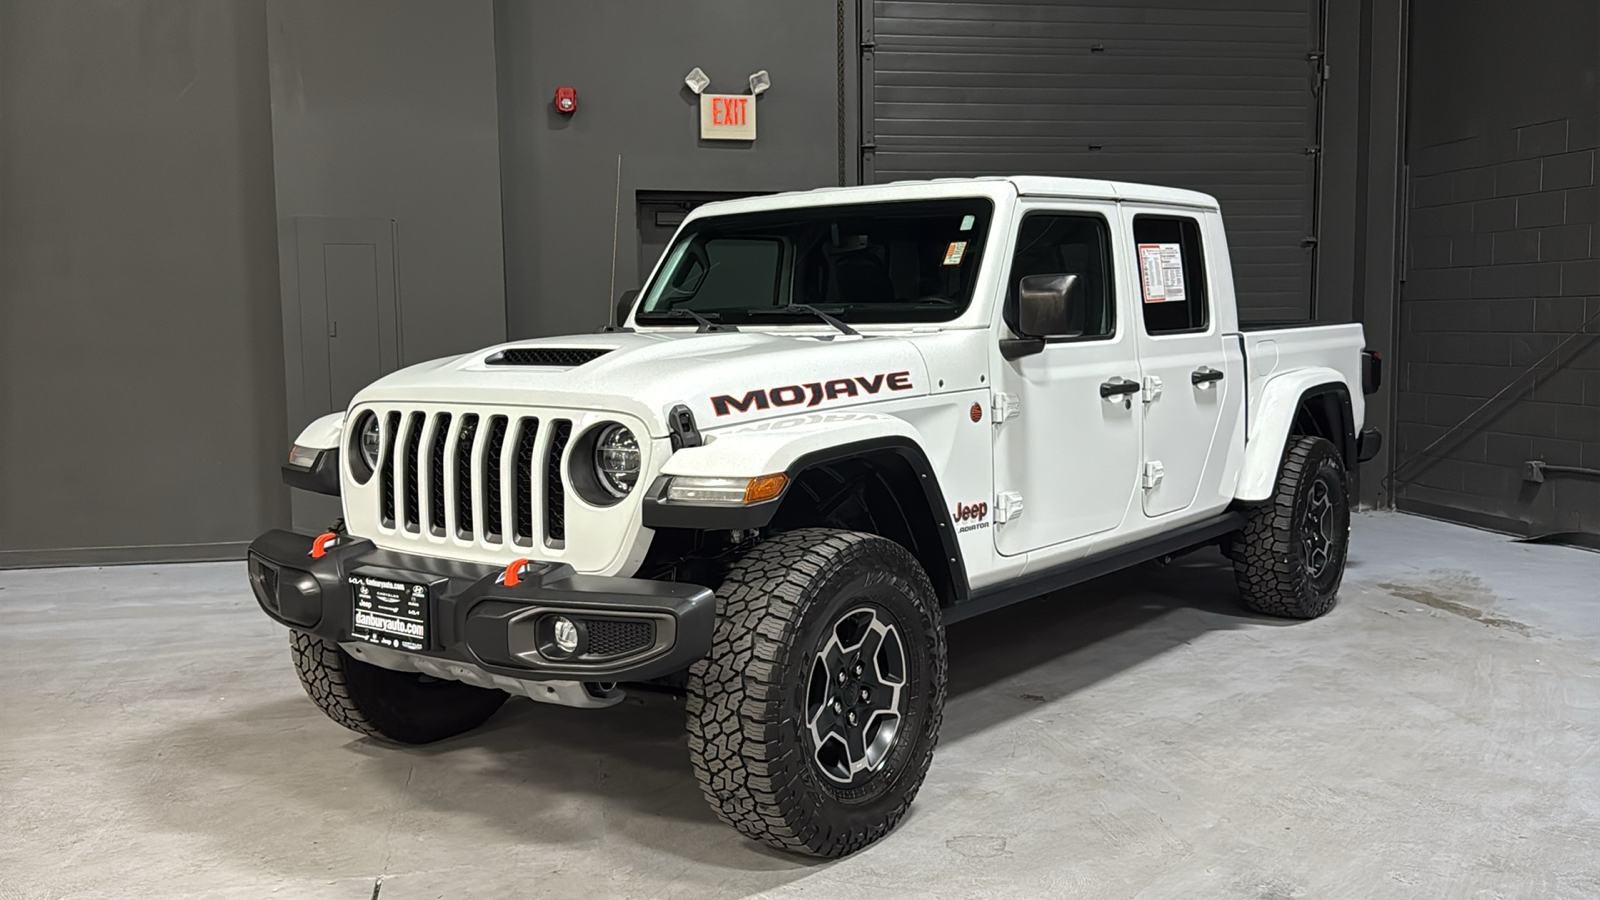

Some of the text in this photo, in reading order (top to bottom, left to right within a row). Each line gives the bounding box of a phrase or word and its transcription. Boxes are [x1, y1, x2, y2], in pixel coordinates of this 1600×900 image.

[711, 97, 748, 126] EXIT
[710, 371, 914, 417] MOJAVE
[952, 501, 988, 523] Jeep
[359, 600, 372, 609] Jeep
[355, 611, 424, 636] danburyauto.com
